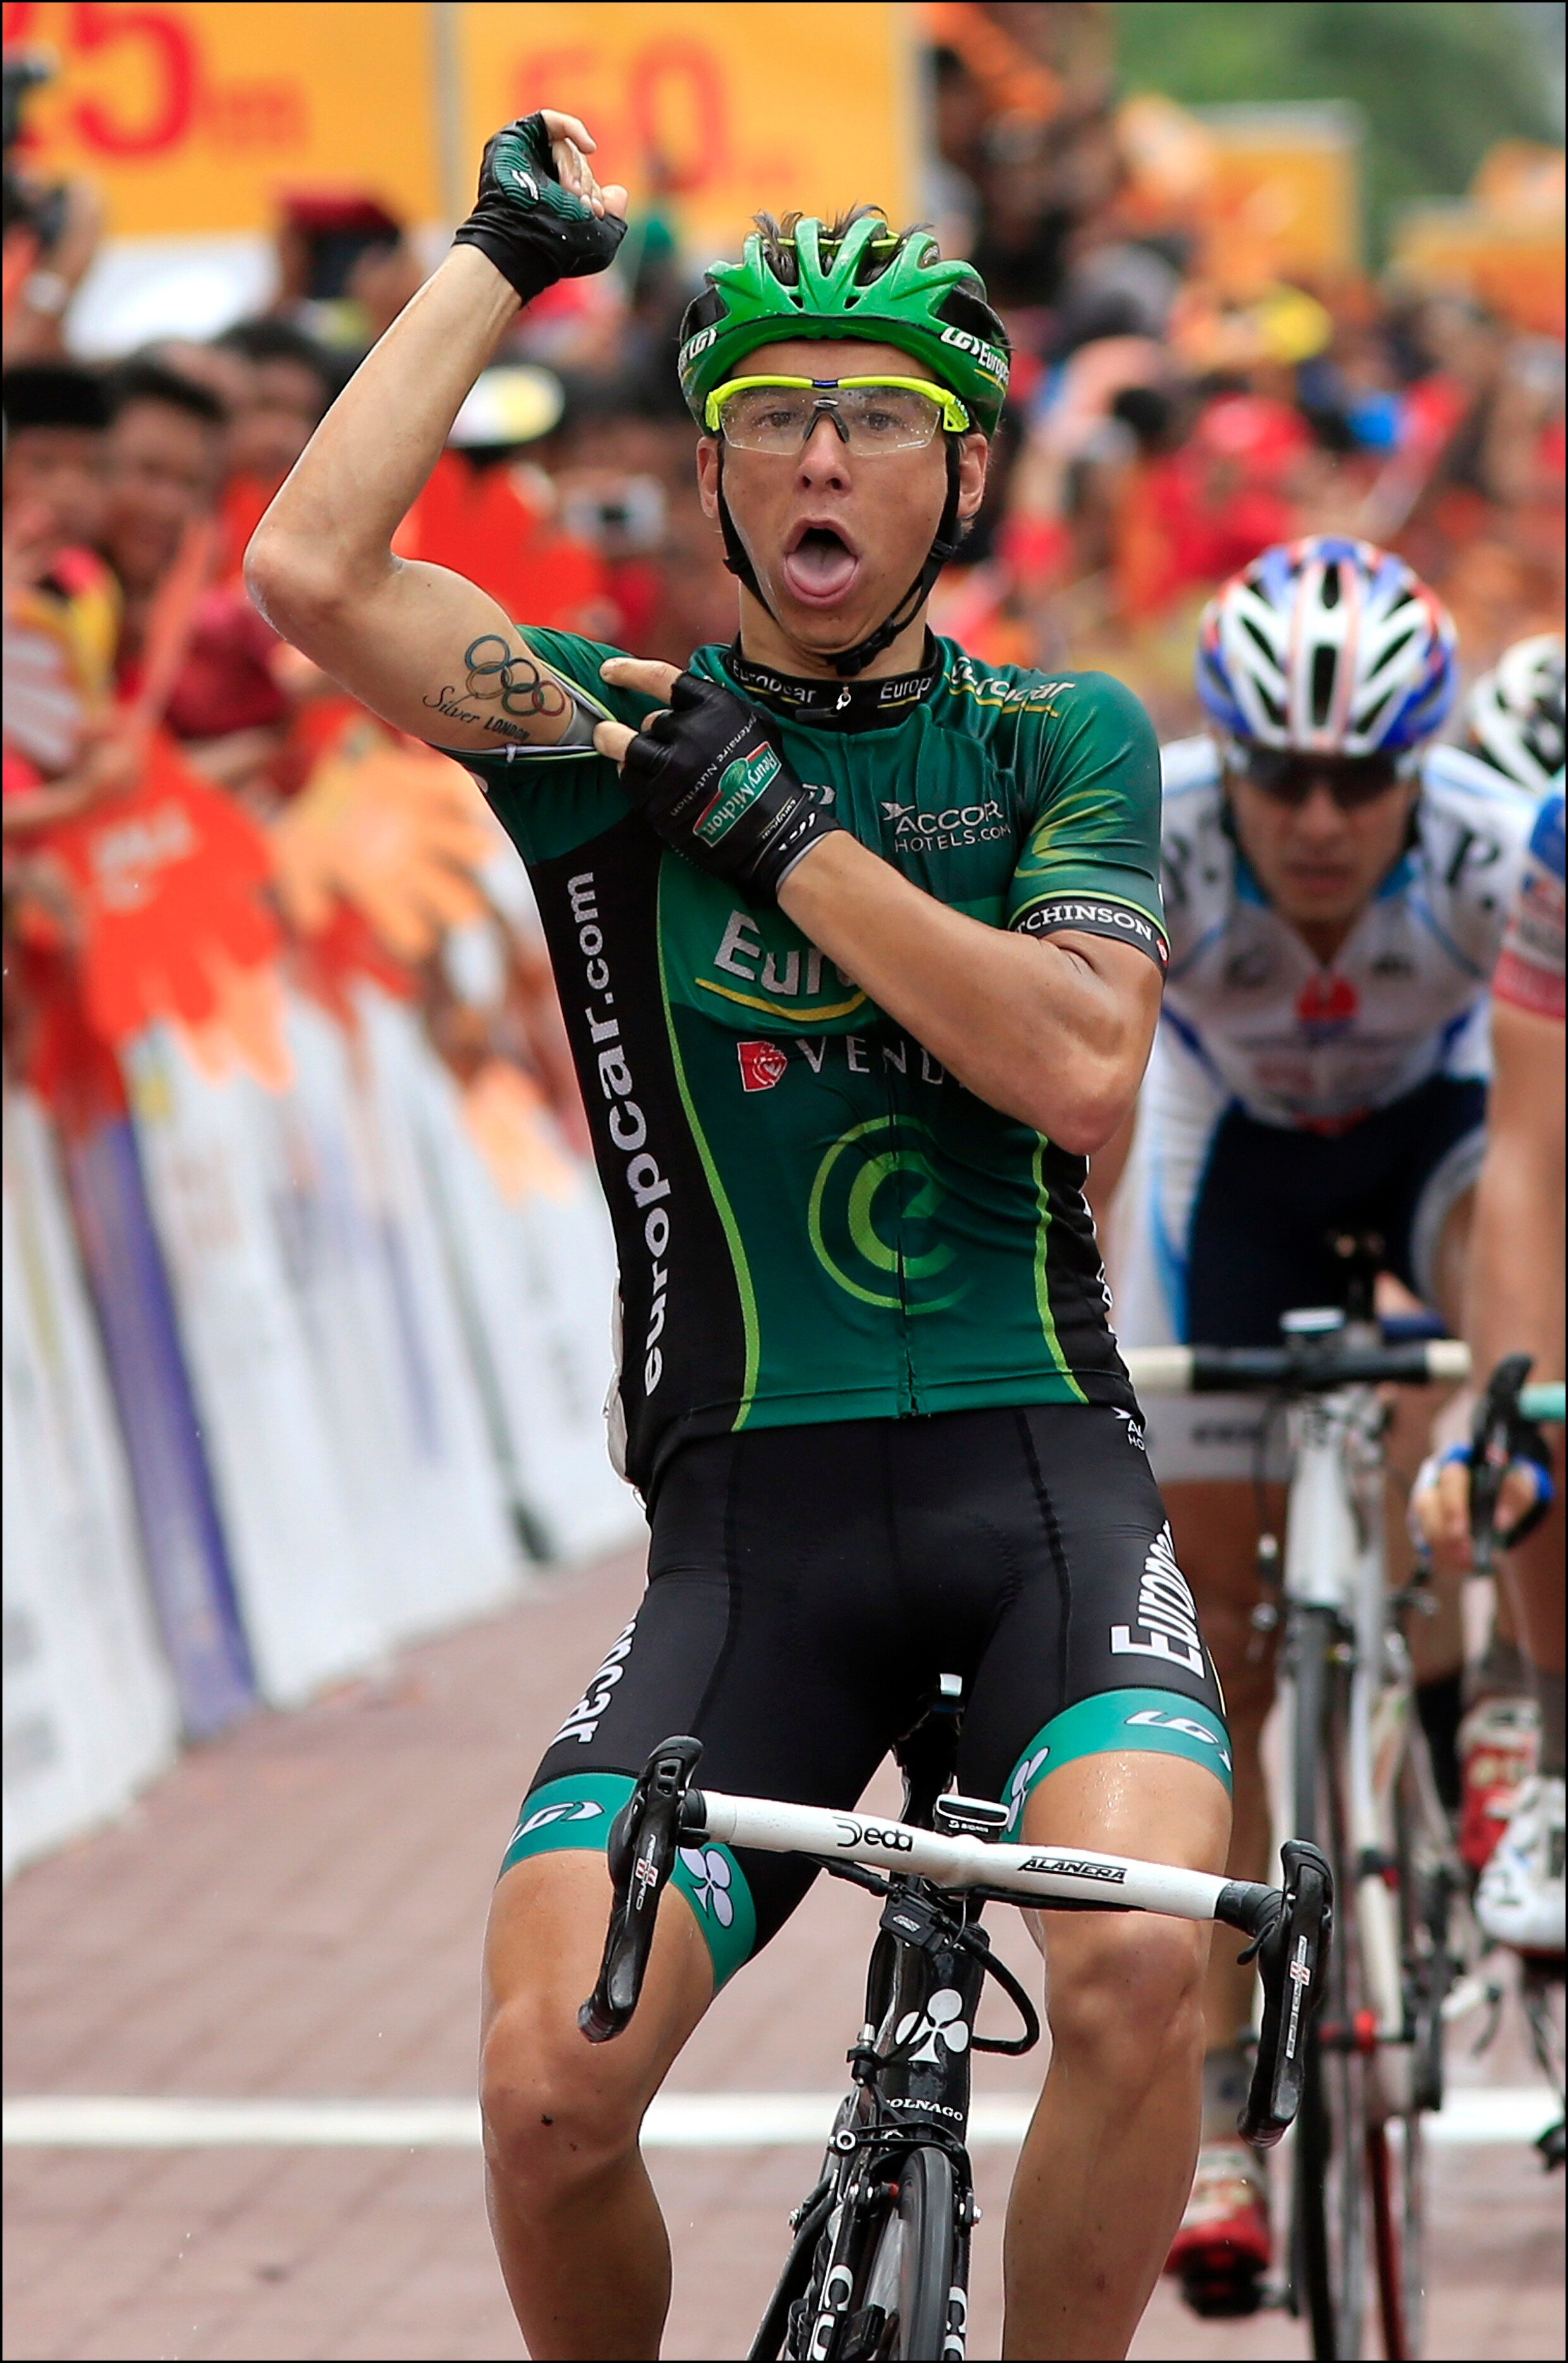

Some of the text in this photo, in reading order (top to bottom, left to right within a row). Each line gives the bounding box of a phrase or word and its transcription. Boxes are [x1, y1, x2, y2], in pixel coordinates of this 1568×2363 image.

[422, 685, 530, 740] Silver LONDON
[702, 785, 755, 835] Michon
[895, 799, 1004, 835] ACCOR
[894, 824, 1012, 853] HOTELS.COM
[795, 1035, 947, 1084] VEND
[567, 871, 672, 1397] europcar.com
[831, 1816, 914, 1852] Deda
[886, 2097, 964, 2121] OLNAGO
